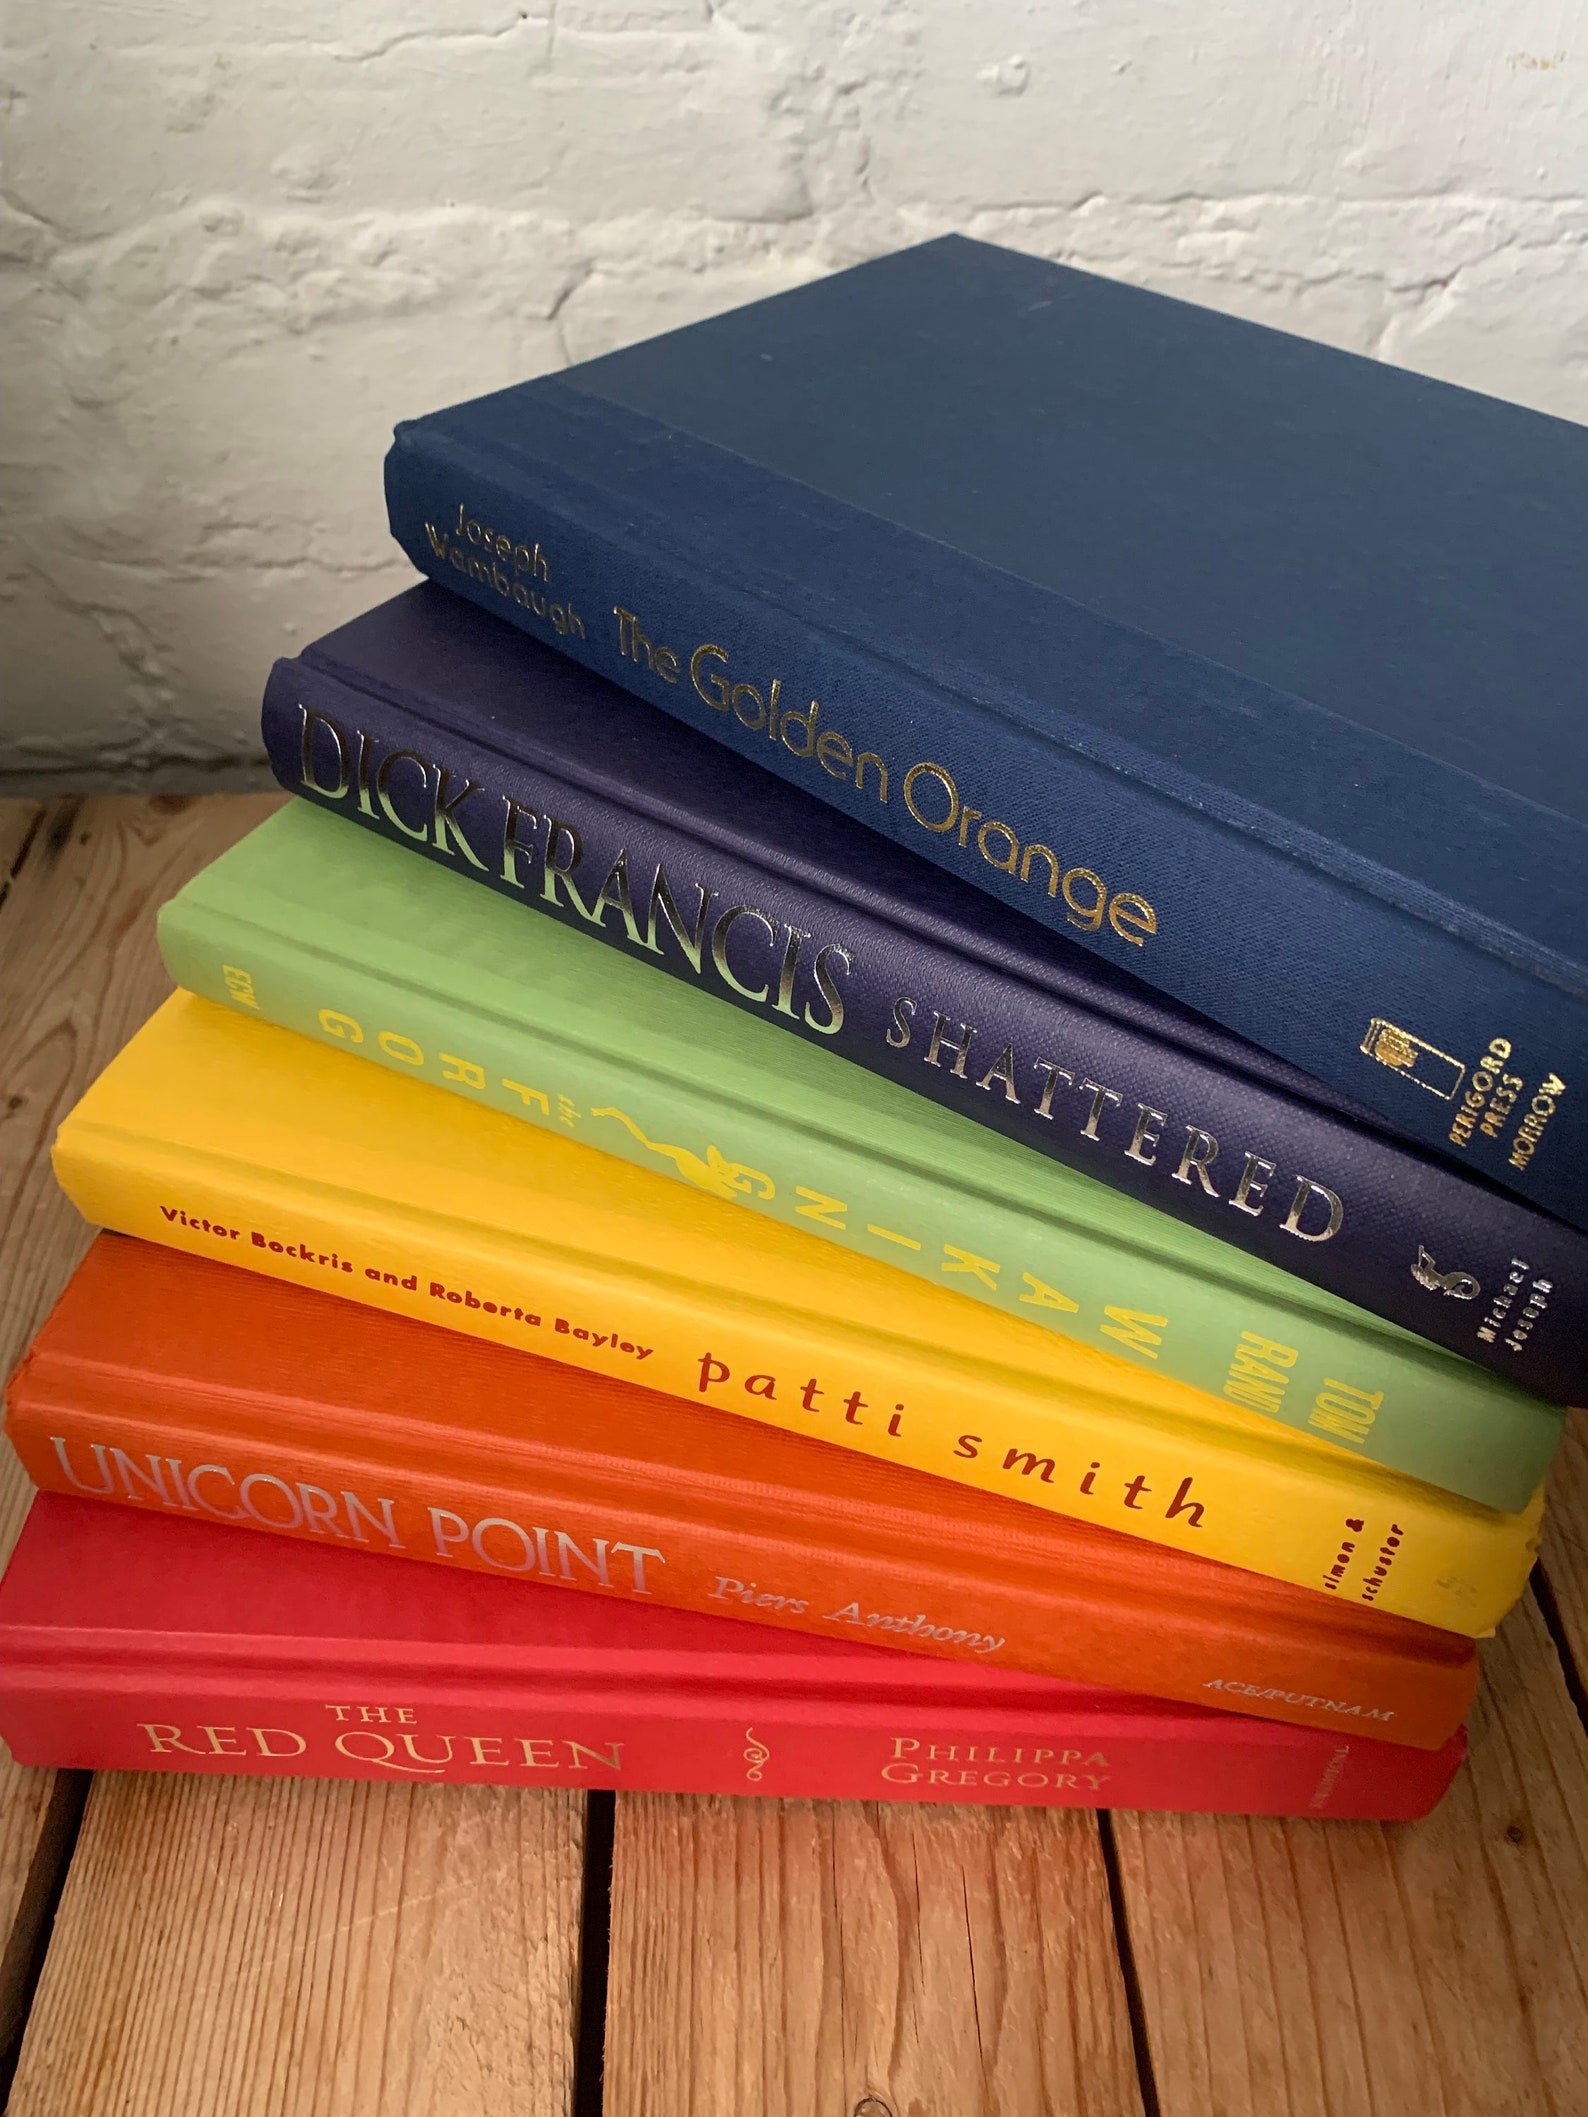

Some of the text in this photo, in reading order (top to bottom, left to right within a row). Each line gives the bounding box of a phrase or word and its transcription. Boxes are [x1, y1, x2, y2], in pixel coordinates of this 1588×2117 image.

[424, 521, 586, 640] Wambaugh
[454, 503, 550, 582] Joseph
[613, 606, 1158, 947] The Golden Orange
[298, 703, 1344, 1243] DICK FRANCIS SHATTERED
[318, 1008, 552, 1117] FROG
[1449, 1037, 1513, 1148] PERIGORD
[1480, 1072, 1525, 1140] PRESS
[1508, 1072, 1567, 1172] MORROW
[160, 1205, 654, 1361] Victor Bockris and Roberta Bayley
[1476, 1257, 1530, 1345] Michael
[1506, 1278, 1554, 1352] Joseph
[1222, 1330, 1299, 1414] RAND
[1307, 1378, 1385, 1445] TOM
[697, 1352, 1206, 1528] patti smith
[50, 1436, 666, 1595] UNICORN POINT
[1323, 1517, 1365, 1590] simon &
[1361, 1524, 1405, 1601] schuster
[707, 1575, 1006, 1654] Piers Anthony
[325, 1704, 417, 1725] THE
[1203, 1677, 1395, 1722] ACE/PUTNAM
[136, 1723, 624, 1773] RED QUEEN
